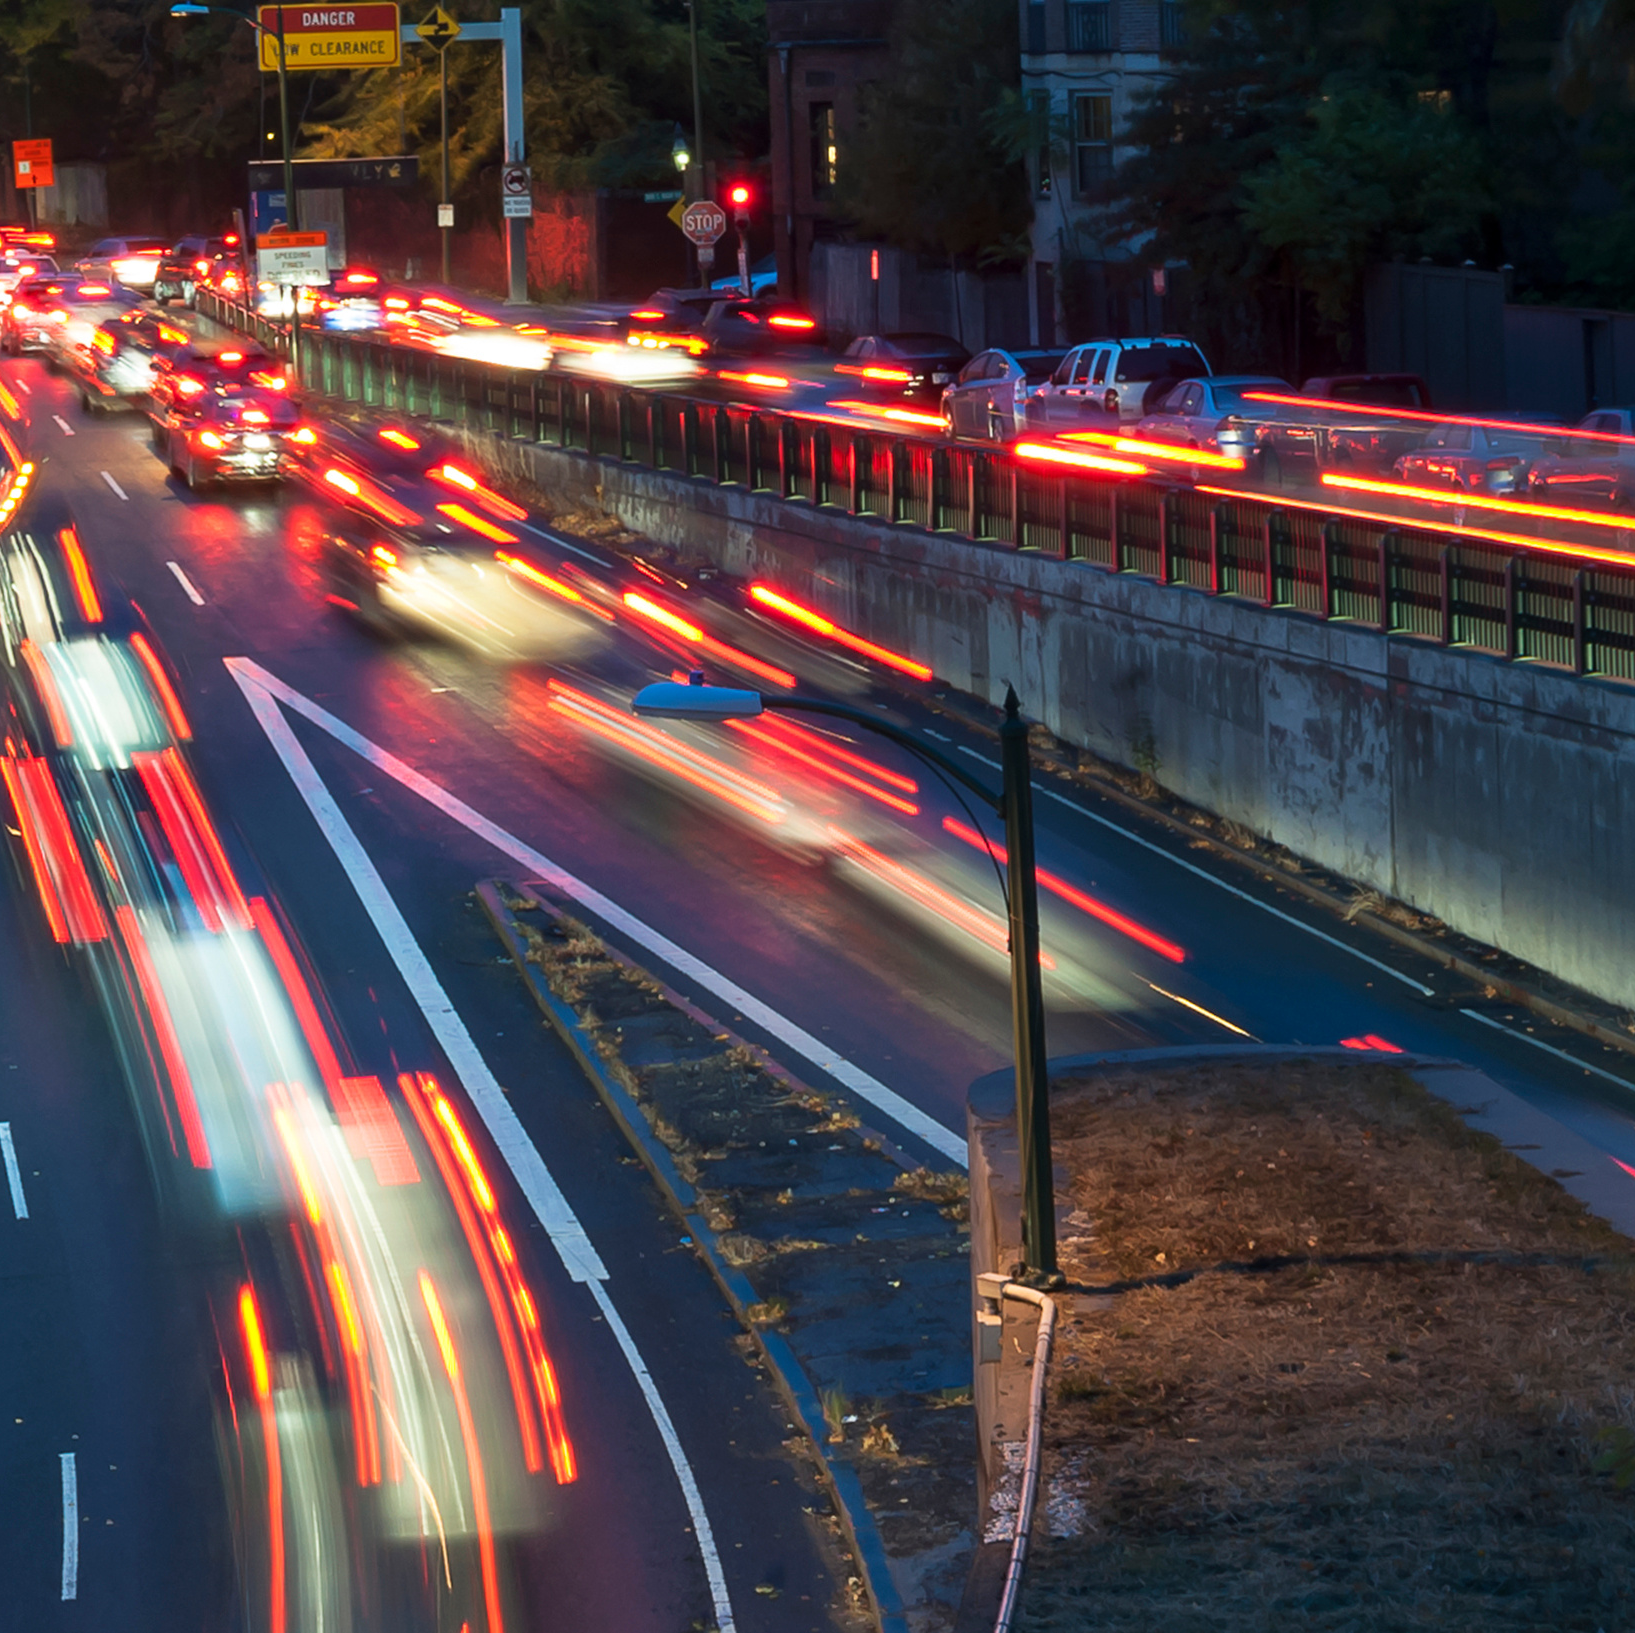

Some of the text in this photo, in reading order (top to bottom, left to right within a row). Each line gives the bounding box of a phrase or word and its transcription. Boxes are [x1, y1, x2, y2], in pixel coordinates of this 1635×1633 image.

[302, 11, 356, 27] DANGER
[310, 40, 385, 56] CLEARANCE
[686, 214, 722, 231] STOP
[274, 251, 311, 260] SPEEDING
[281, 261, 304, 269] FINES
